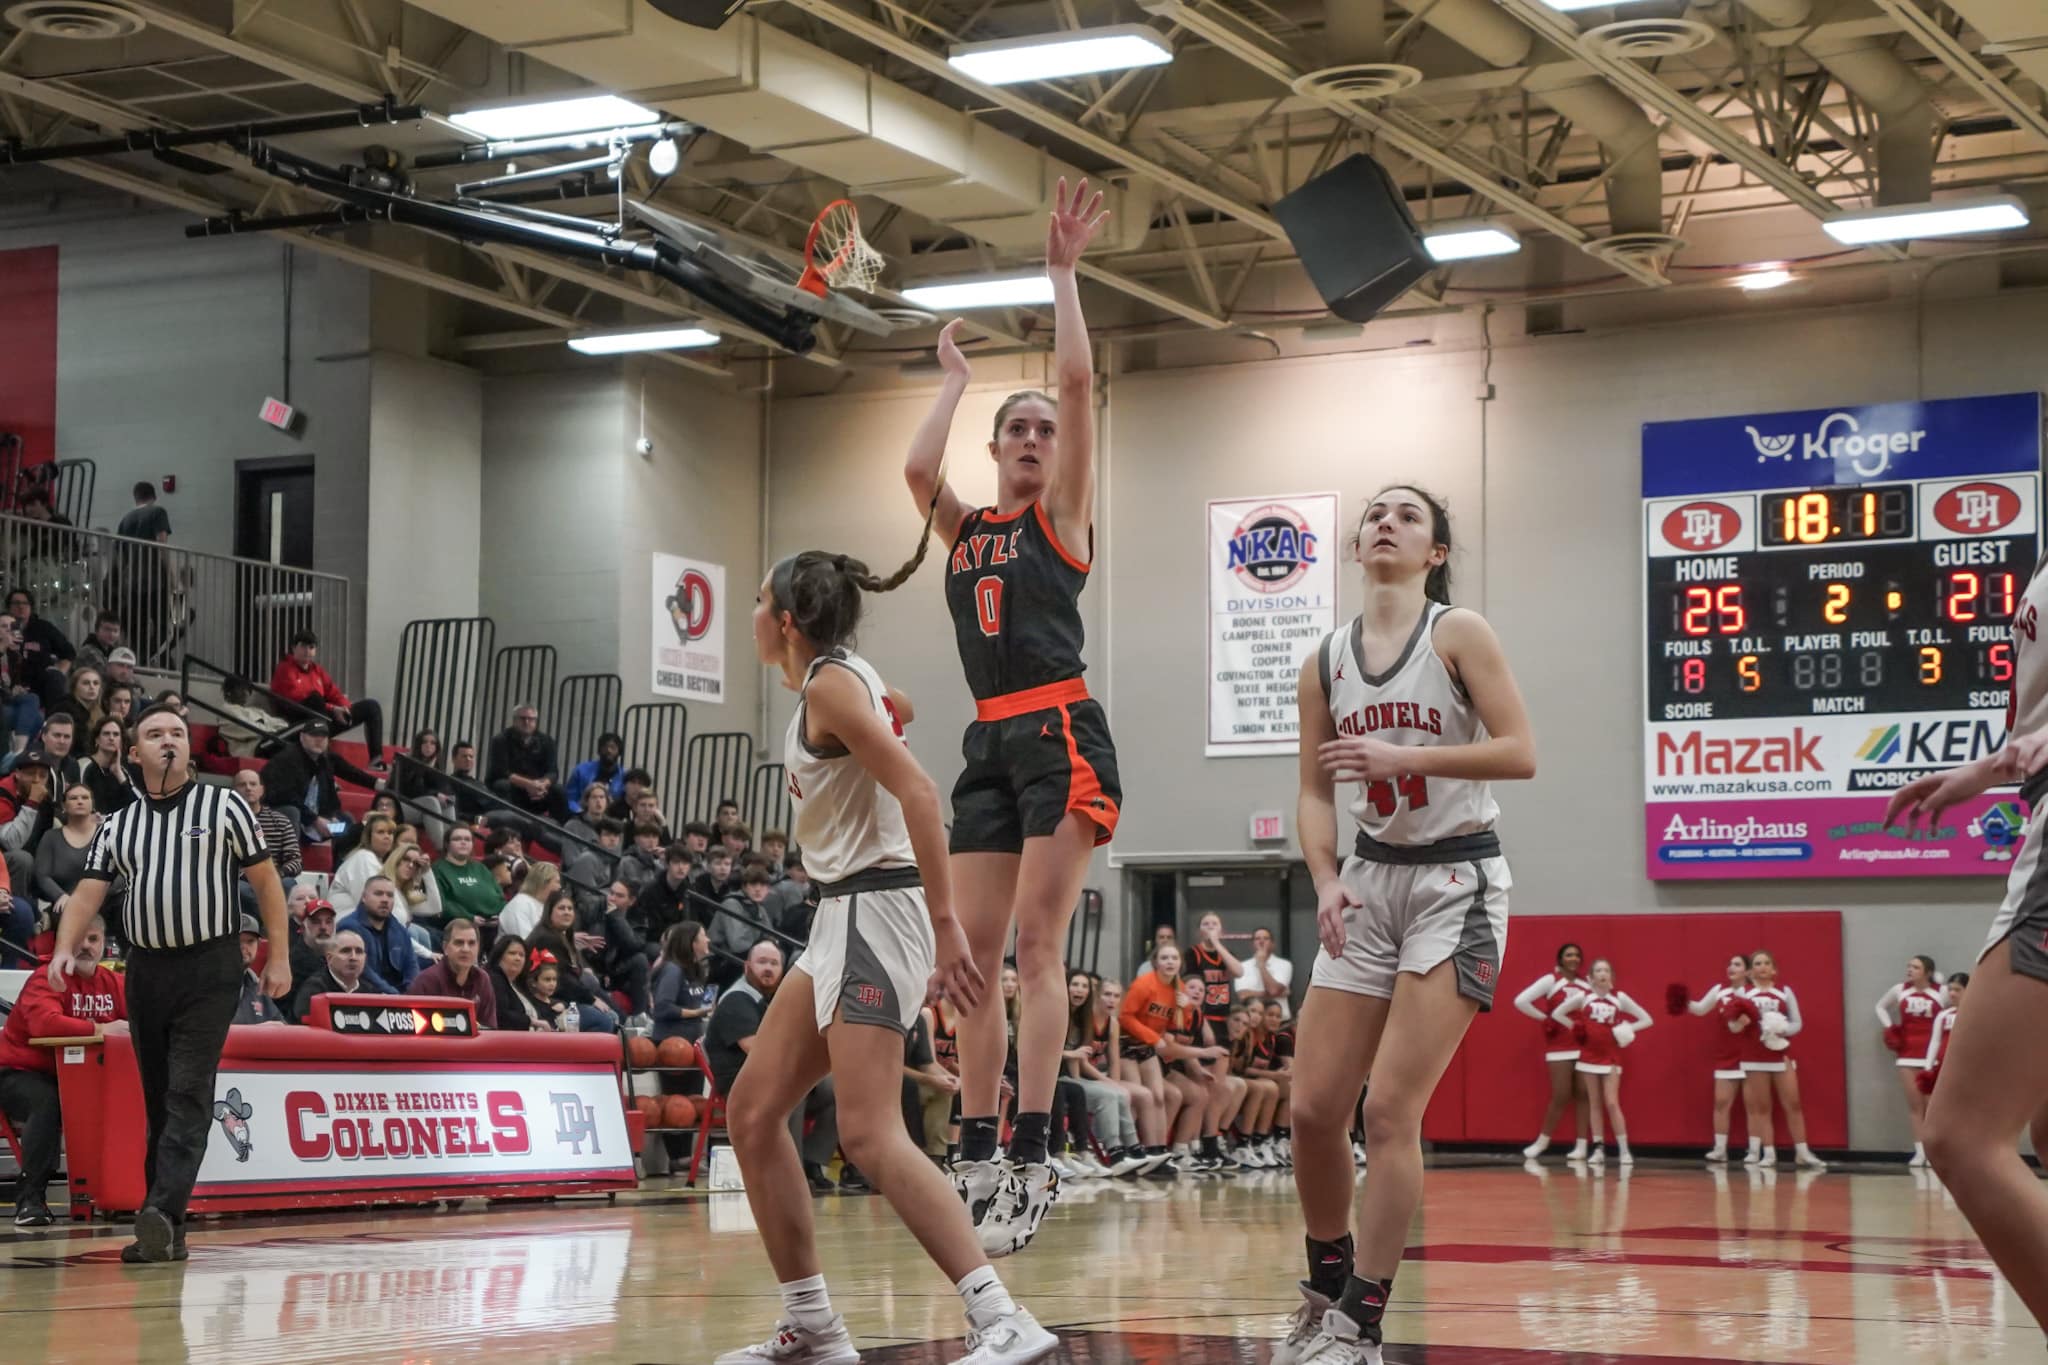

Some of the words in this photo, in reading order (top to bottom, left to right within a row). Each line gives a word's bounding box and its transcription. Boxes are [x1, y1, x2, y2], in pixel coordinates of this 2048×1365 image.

[1803, 412, 1926, 477] Kroger
[1783, 492, 1876, 543] 18.1
[1227, 527, 1317, 570] NKAC
[1933, 540, 2012, 567] GUEST
[1675, 557, 1739, 581] HOME
[1808, 562, 1865, 580] PERIOD
[975, 574, 1004, 637] 0
[1227, 596, 1307, 611] DIVISION
[1824, 584, 1851, 625] 2
[1949, 572, 2015, 621] 21
[1684, 586, 1745, 635] 25
[1232, 617, 1266, 628] BOONE
[1272, 614, 1312, 625] COUNTY
[1222, 630, 1276, 641] CAMPBELL
[1281, 627, 1321, 638] COUNTY
[1784, 635, 1841, 652] PLAYER
[1851, 631, 1891, 648] FOUL
[1907, 629, 1951, 646] T.O.L.
[1251, 642, 1292, 653] CONNER
[1664, 640, 1712, 657] FOULS
[1729, 638, 1771, 654] T.O.L.
[1252, 656, 1291, 667] COOPER
[1919, 647, 1943, 685] 3
[1988, 644, 2013, 682] 5
[656, 670, 684, 689] CHEER
[687, 675, 721, 694] SECTION
[1217, 669, 1274, 681] COVINGTON
[1683, 658, 1706, 693] 8
[1738, 656, 1761, 692] 5
[1234, 684, 1259, 694] DIXIE
[1238, 697, 1270, 707] NOTRE
[1664, 702, 1713, 719] SCORE
[1812, 697, 1865, 714] MATCH
[1260, 710, 1284, 719] RYLE
[1338, 701, 1442, 736] OLONELS
[1232, 724, 1265, 734] SIMON
[1656, 727, 1825, 776] Mazak
[1652, 778, 1832, 797] www.mazakusa.com
[1855, 771, 1930, 787] WORKS
[1663, 813, 1808, 846] Arlinghaus
[388, 1011, 414, 1030] POSS
[334, 1092, 390, 1112] DIXIE
[396, 1092, 480, 1111] HEIGHTS
[285, 1090, 532, 1162] COLONELS
